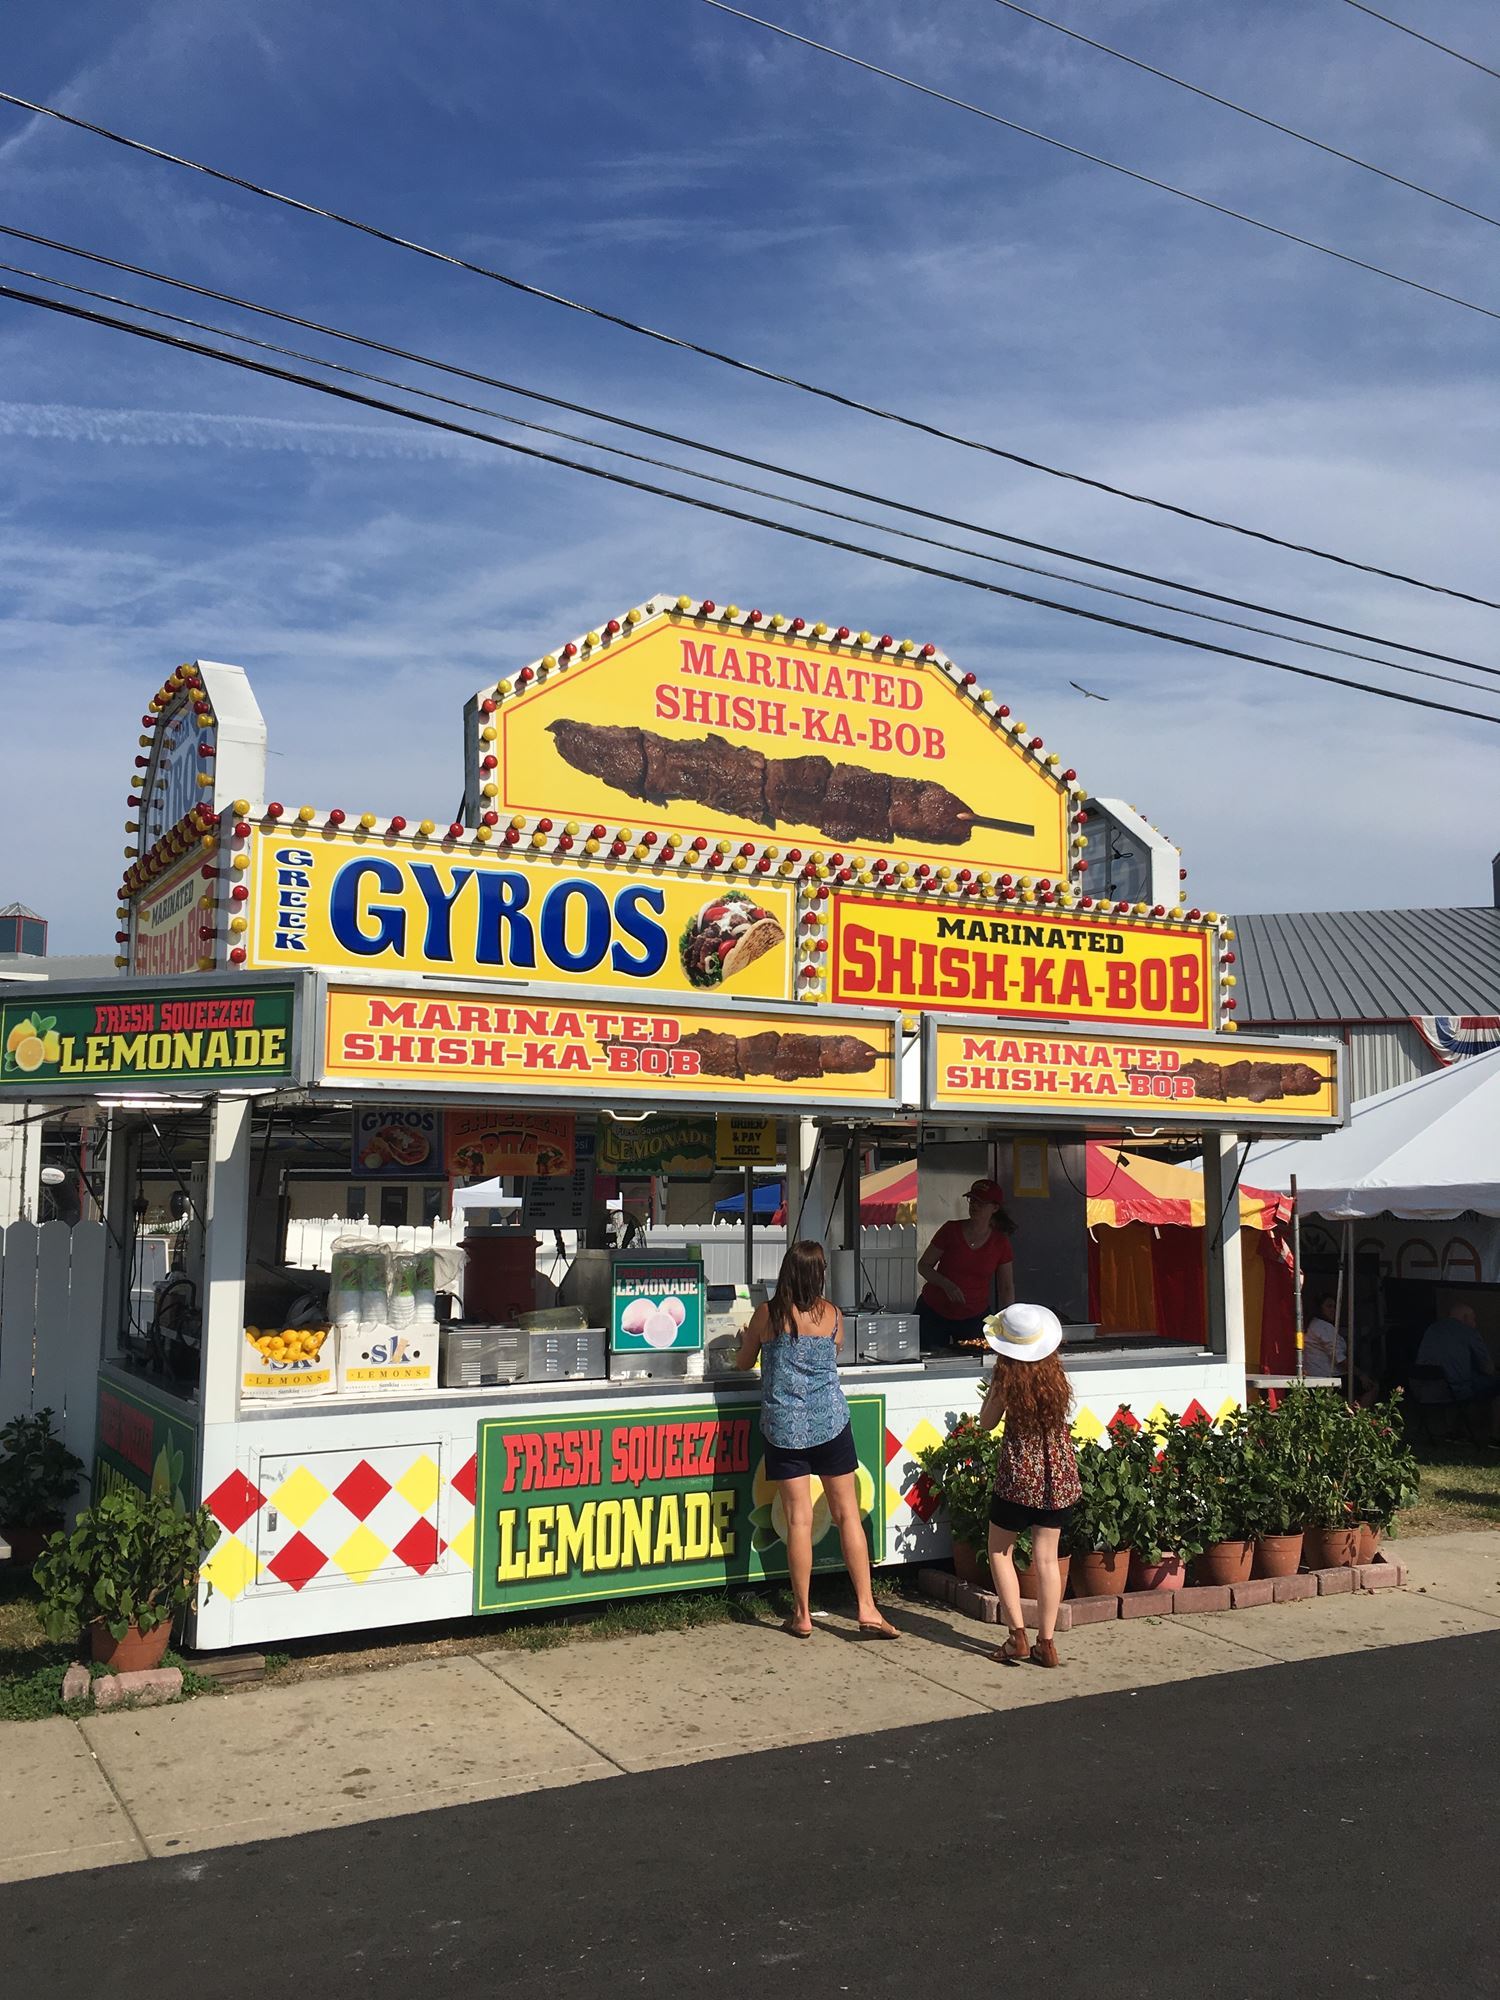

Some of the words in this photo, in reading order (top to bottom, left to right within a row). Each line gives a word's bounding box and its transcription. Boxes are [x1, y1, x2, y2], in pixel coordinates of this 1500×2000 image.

[680, 640, 923, 711] MARINATED
[655, 684, 946, 760] SHISH-KA-BOB
[151, 878, 194, 929] MARINATED
[274, 849, 314, 951] GREEK
[330, 856, 669, 977] GYROS
[936, 916, 1124, 955] MARINATED
[843, 923, 1201, 1015] SHISH-KA-BOB
[93, 1003, 154, 1034] FRESH
[160, 998, 256, 1033] SQUEEZED
[368, 1000, 681, 1044] MARINATED
[59, 1028, 286, 1073] LEMONADE
[343, 1034, 701, 1077] SHISH-KA-BOB
[962, 1038, 1180, 1072] MARINATED
[946, 1066, 1196, 1099] SHISH-KA-BOB
[361, 1111, 434, 1131] GYROS
[741, 1132, 762, 1142] PAY
[480, 1131, 538, 1154] PITA
[607, 1127, 712, 1162] LEMONADE
[734, 1145, 760, 1155] HERE
[616, 1278, 698, 1296] LEMONADE
[256, 1374, 322, 1385] LEMONS
[357, 1370, 422, 1379] LEMONS
[501, 1429, 600, 1492] FRESH
[611, 1420, 751, 1488] SQUEEZED
[497, 1490, 735, 1582] LEMONADE
